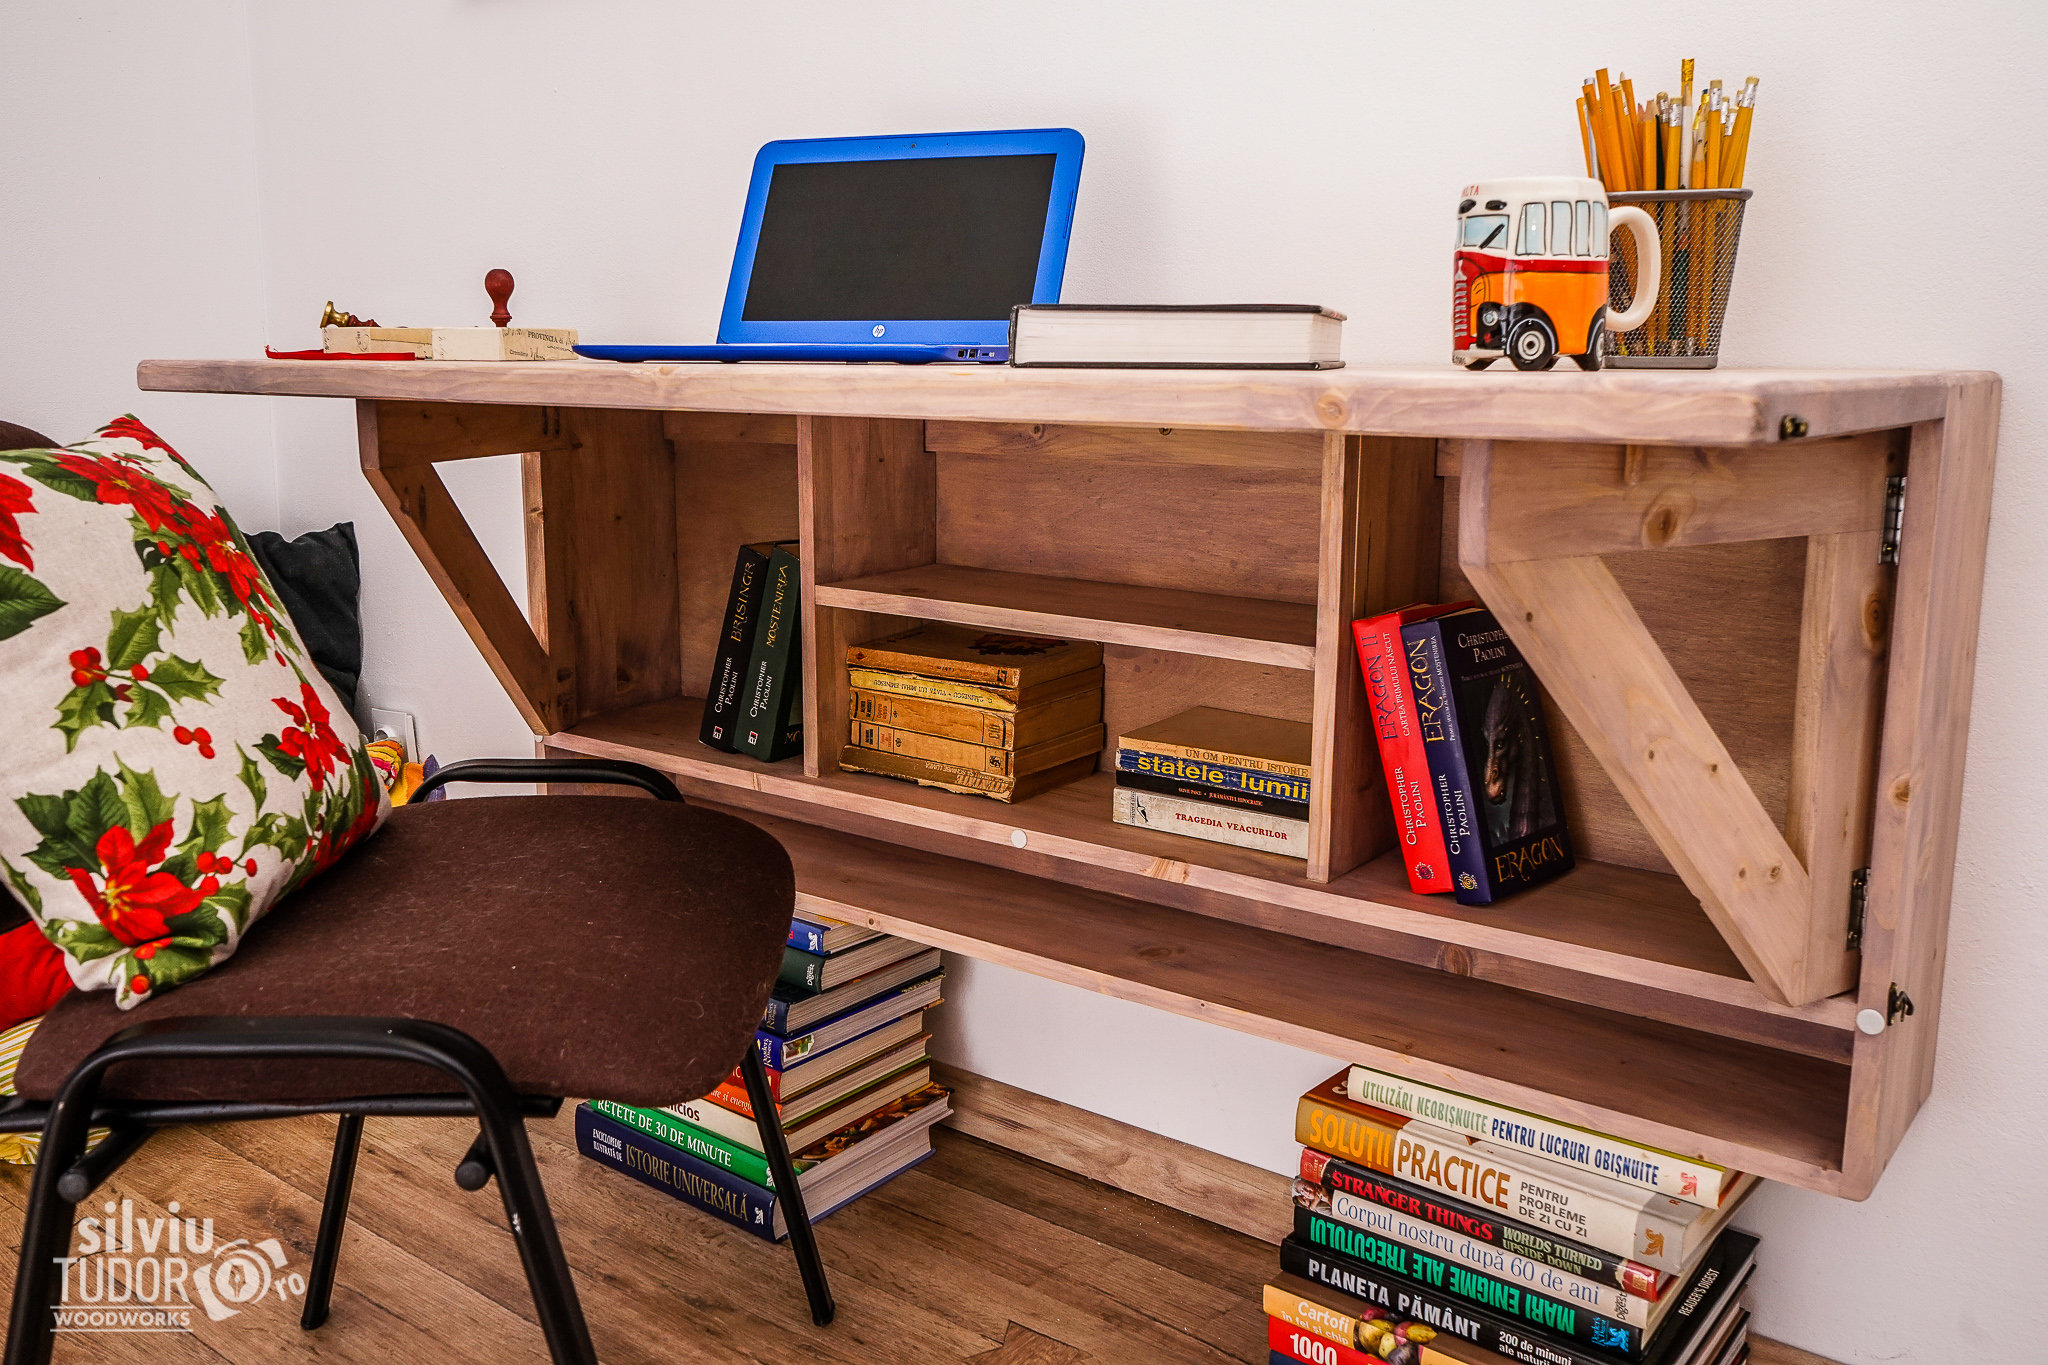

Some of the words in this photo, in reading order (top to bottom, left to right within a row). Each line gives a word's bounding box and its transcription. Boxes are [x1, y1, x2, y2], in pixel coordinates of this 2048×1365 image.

[731, 562, 756, 643] BRISINGR
[1473, 646, 1507, 663] PAOLINI
[714, 657, 733, 713] CHRISTOPHER
[725, 671, 739, 706] PAOLINI
[750, 660, 768, 718] CHRISTOPHER
[759, 675, 773, 710] PAOLINI
[1368, 654, 1398, 741] ERAGON
[1390, 666, 1404, 703] PRIMULUI
[1407, 637, 1445, 743] ERAGON
[1396, 704, 1410, 737] CARTEA
[1137, 756, 1224, 784] statele
[1240, 771, 1308, 800] lumii
[1184, 749, 1200, 759] UN
[1202, 751, 1219, 762] OM
[1222, 755, 1264, 770] PENTRU
[1175, 813, 1223, 828] TRAGEDIA
[1226, 822, 1288, 840] VEACURILOR
[1397, 766, 1418, 846] CHRISTOPHER
[1414, 780, 1427, 827] PAOLINI
[1438, 774, 1461, 855] CHRISTOPHER
[1454, 789, 1471, 837] PAOLINI
[1495, 833, 1565, 883] ERAGON
[638, 1113, 653, 1131] DE
[655, 1121, 667, 1137] 30
[669, 1127, 685, 1146] DE
[687, 1135, 732, 1167] MINUTE
[1310, 1109, 1392, 1168] SOLUȚII
[1362, 1080, 1413, 1112] UTILIZĂRI
[1417, 1096, 1488, 1134] NEOBIȘNUITE
[1492, 1118, 1536, 1148] PENTRU
[1540, 1132, 1590, 1165] LUCRURI
[1594, 1149, 1660, 1186] OBIȘNUITE
[626, 1144, 671, 1185] ISTORIE
[673, 1165, 749, 1222] UNIVERSALĂ
[1397, 1139, 1511, 1210] PRACTICE
[1520, 1181, 1569, 1206] PENTRU
[1331, 1171, 1423, 1218] STRANGER
[1425, 1202, 1494, 1241] THINGS
[1519, 1194, 1587, 1225] PROBLEME
[1519, 1206, 1534, 1220] DE
[1539, 1212, 1551, 1225] ZI
[1555, 1218, 1572, 1232] CU
[1576, 1225, 1588, 1238] ZI
[1310, 1216, 1408, 1275] TRECUTULUI
[1337, 1197, 1393, 1232] Corpul
[1398, 1220, 1454, 1254] nostru
[1460, 1240, 1505, 1272] după
[1510, 1257, 1535, 1281] 60
[1540, 1268, 1563, 1292] de
[1568, 1281, 1600, 1306] ani
[1502, 1225, 1552, 1255] WORLDS
[1554, 1243, 1602, 1271] TURNED
[1502, 1239, 1545, 1263] UPSIDE
[1547, 1254, 1582, 1276] DOWN
[1412, 1252, 1447, 1287] ALE
[1450, 1268, 1520, 1315] ENIGME
[1678, 1286, 1707, 1317] READER'S
[1698, 1267, 1720, 1290] DIGEST
[1298, 1302, 1350, 1333] Cartofi
[1308, 1258, 1390, 1307] PLANETA
[1397, 1294, 1481, 1341] PĂMÂNT
[1525, 1293, 1576, 1335] MARI
[1281, 1311, 1293, 1323] în
[1295, 1315, 1310, 1329] fel
[1324, 1328, 1349, 1346] chip
[1289, 1333, 1338, 1365] 1000
[1499, 1331, 1519, 1347] 200
[1520, 1340, 1534, 1353] de
[1535, 1346, 1572, 1365] minuni
[1499, 1344, 1515, 1356] ale
